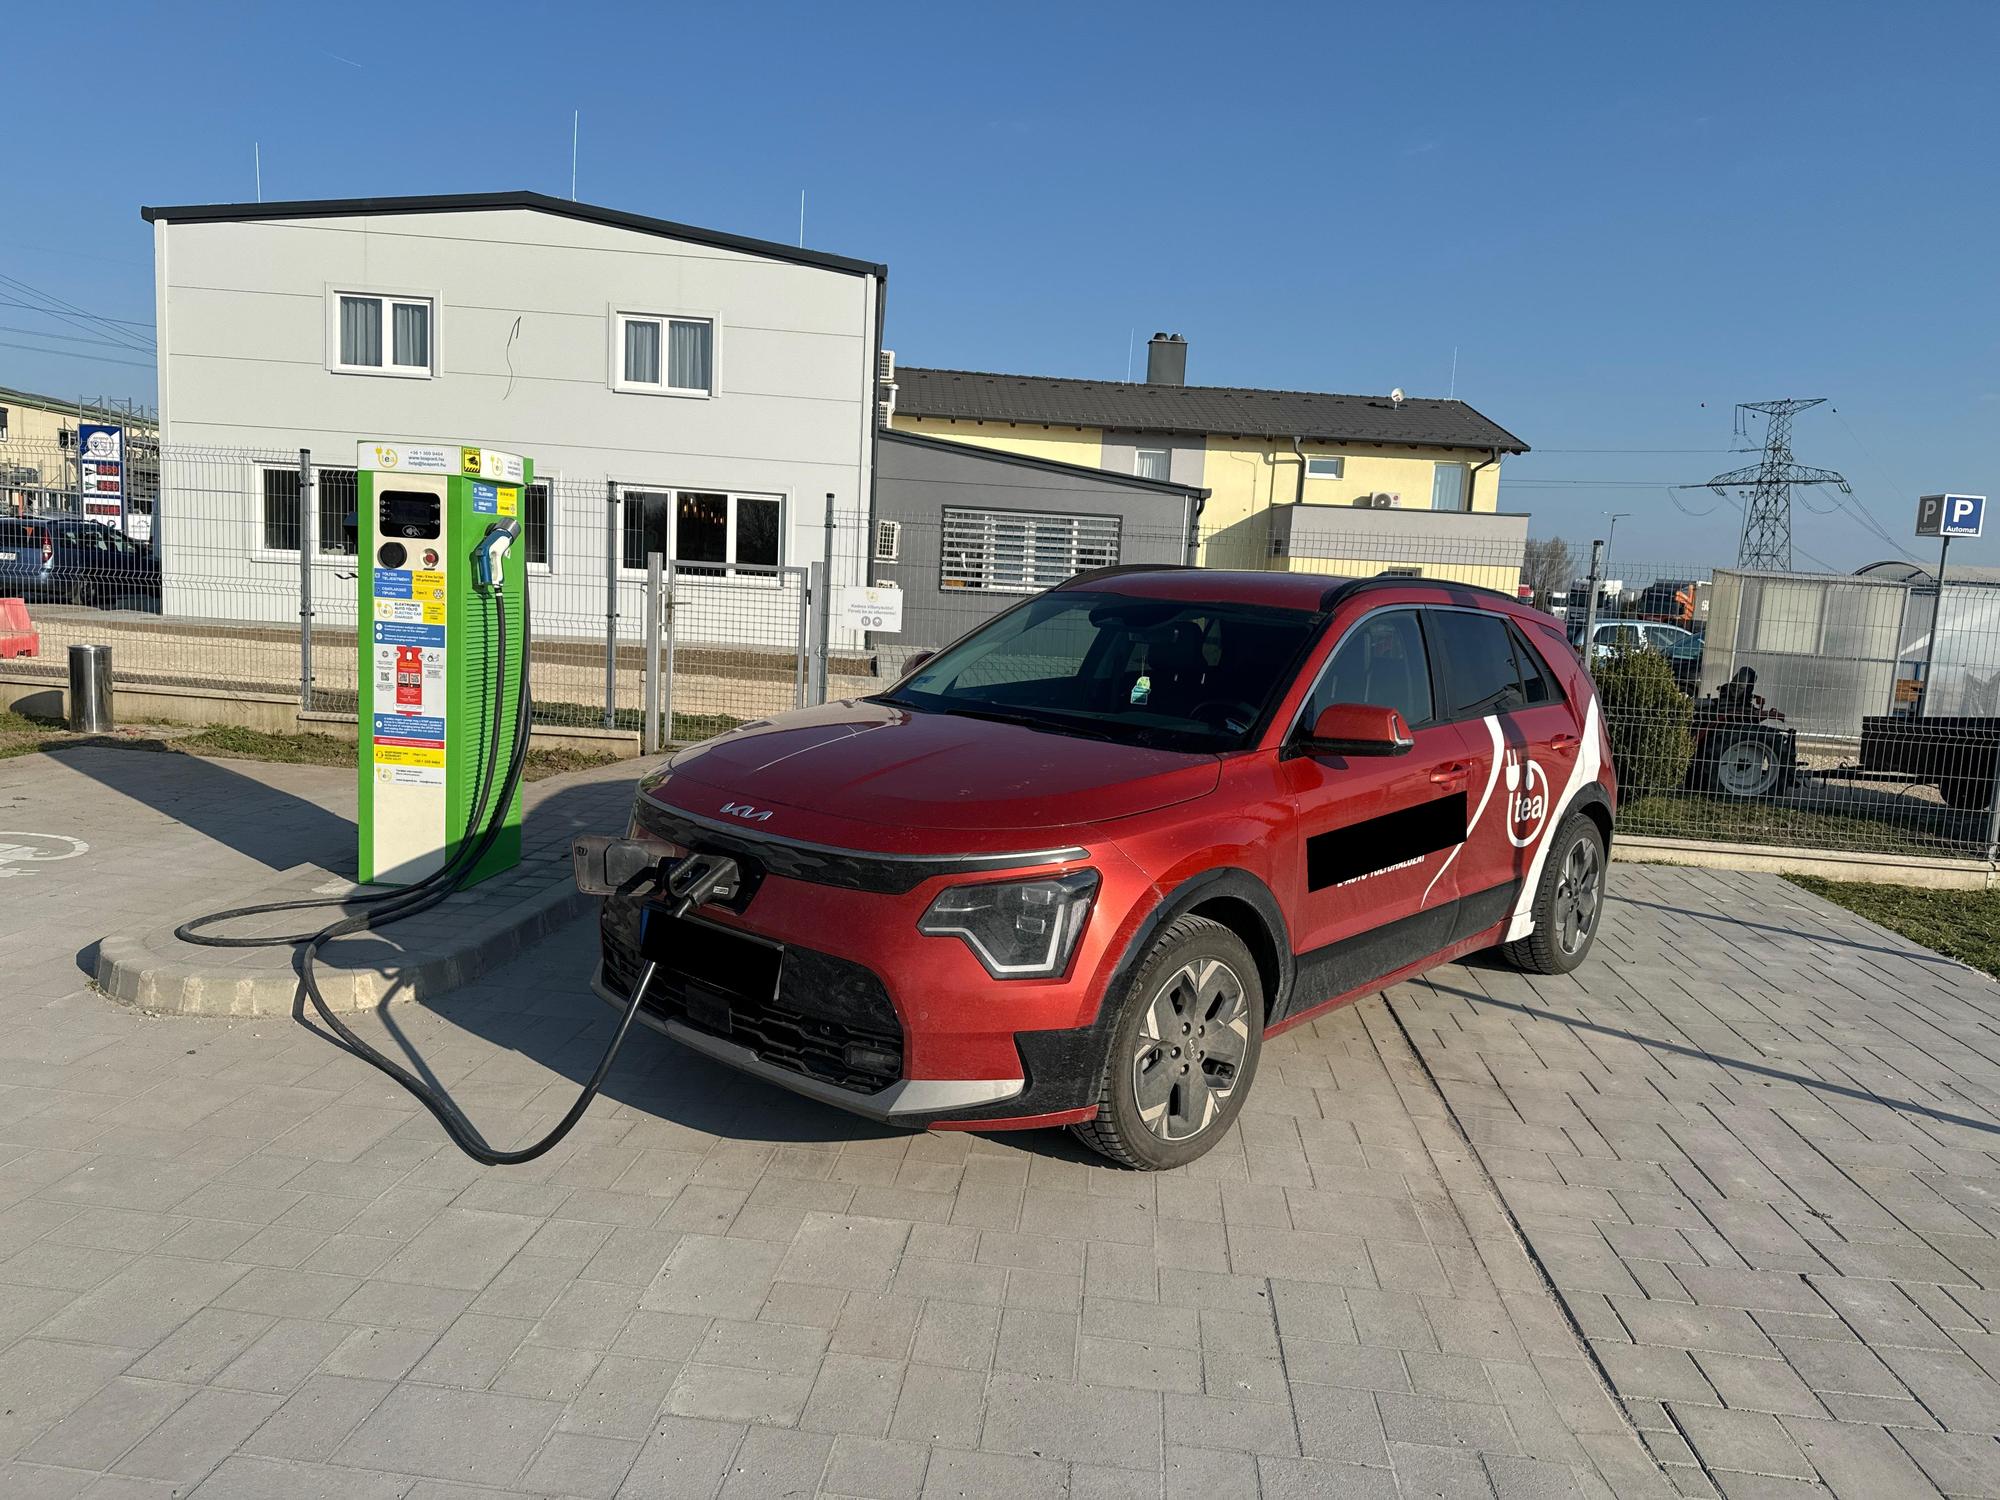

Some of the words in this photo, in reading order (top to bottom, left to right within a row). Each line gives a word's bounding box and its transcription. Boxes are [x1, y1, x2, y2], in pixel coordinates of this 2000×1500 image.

[1923, 500, 1937, 523] P
[1953, 500, 1974, 523] P
[1946, 525, 1977, 534] Automat
[720, 802, 773, 821] KIA
[1514, 791, 1543, 823] tea
